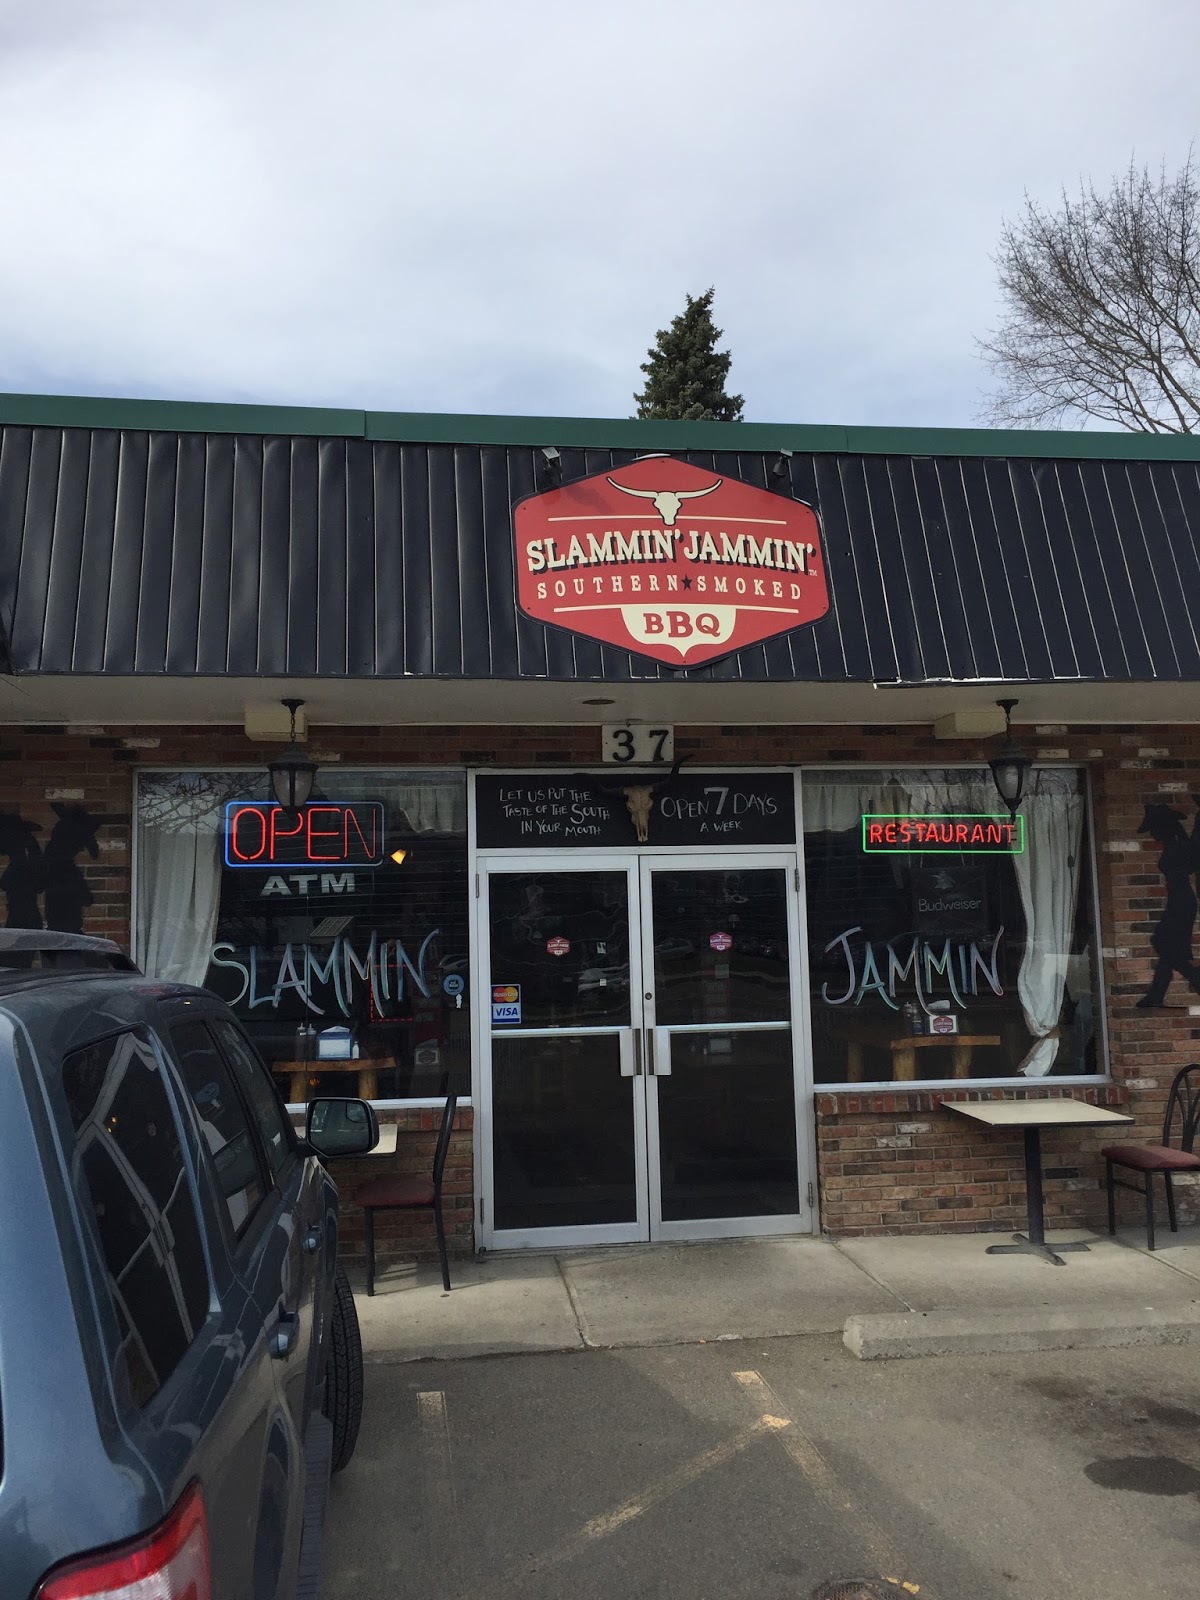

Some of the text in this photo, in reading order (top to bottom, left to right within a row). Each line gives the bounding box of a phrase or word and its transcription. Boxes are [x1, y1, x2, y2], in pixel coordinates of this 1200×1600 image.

[526, 528, 683, 572] SLAMMIN'
[684, 531, 813, 571] JAMMIN'
[537, 574, 801, 600] SOUTHERN SMOKED
[643, 611, 720, 638] BBQ
[612, 729, 669, 762] 37
[499, 787, 592, 803] LET US PUT THE
[660, 786, 777, 819] OPEN 7 DAYS
[502, 803, 610, 824] TASTE OF THE SOUTH
[232, 808, 376, 860] OPEN
[521, 819, 601, 836] IN YOUR MOUTH
[700, 821, 743, 832] A WEEK
[869, 823, 1015, 844] RESTAURANT
[260, 873, 355, 896] ATM
[918, 898, 982, 912] Budweiser
[212, 928, 440, 1017] SLAMMIN
[822, 926, 1004, 1016] JAMMIN
[495, 1007, 518, 1016] VISA
